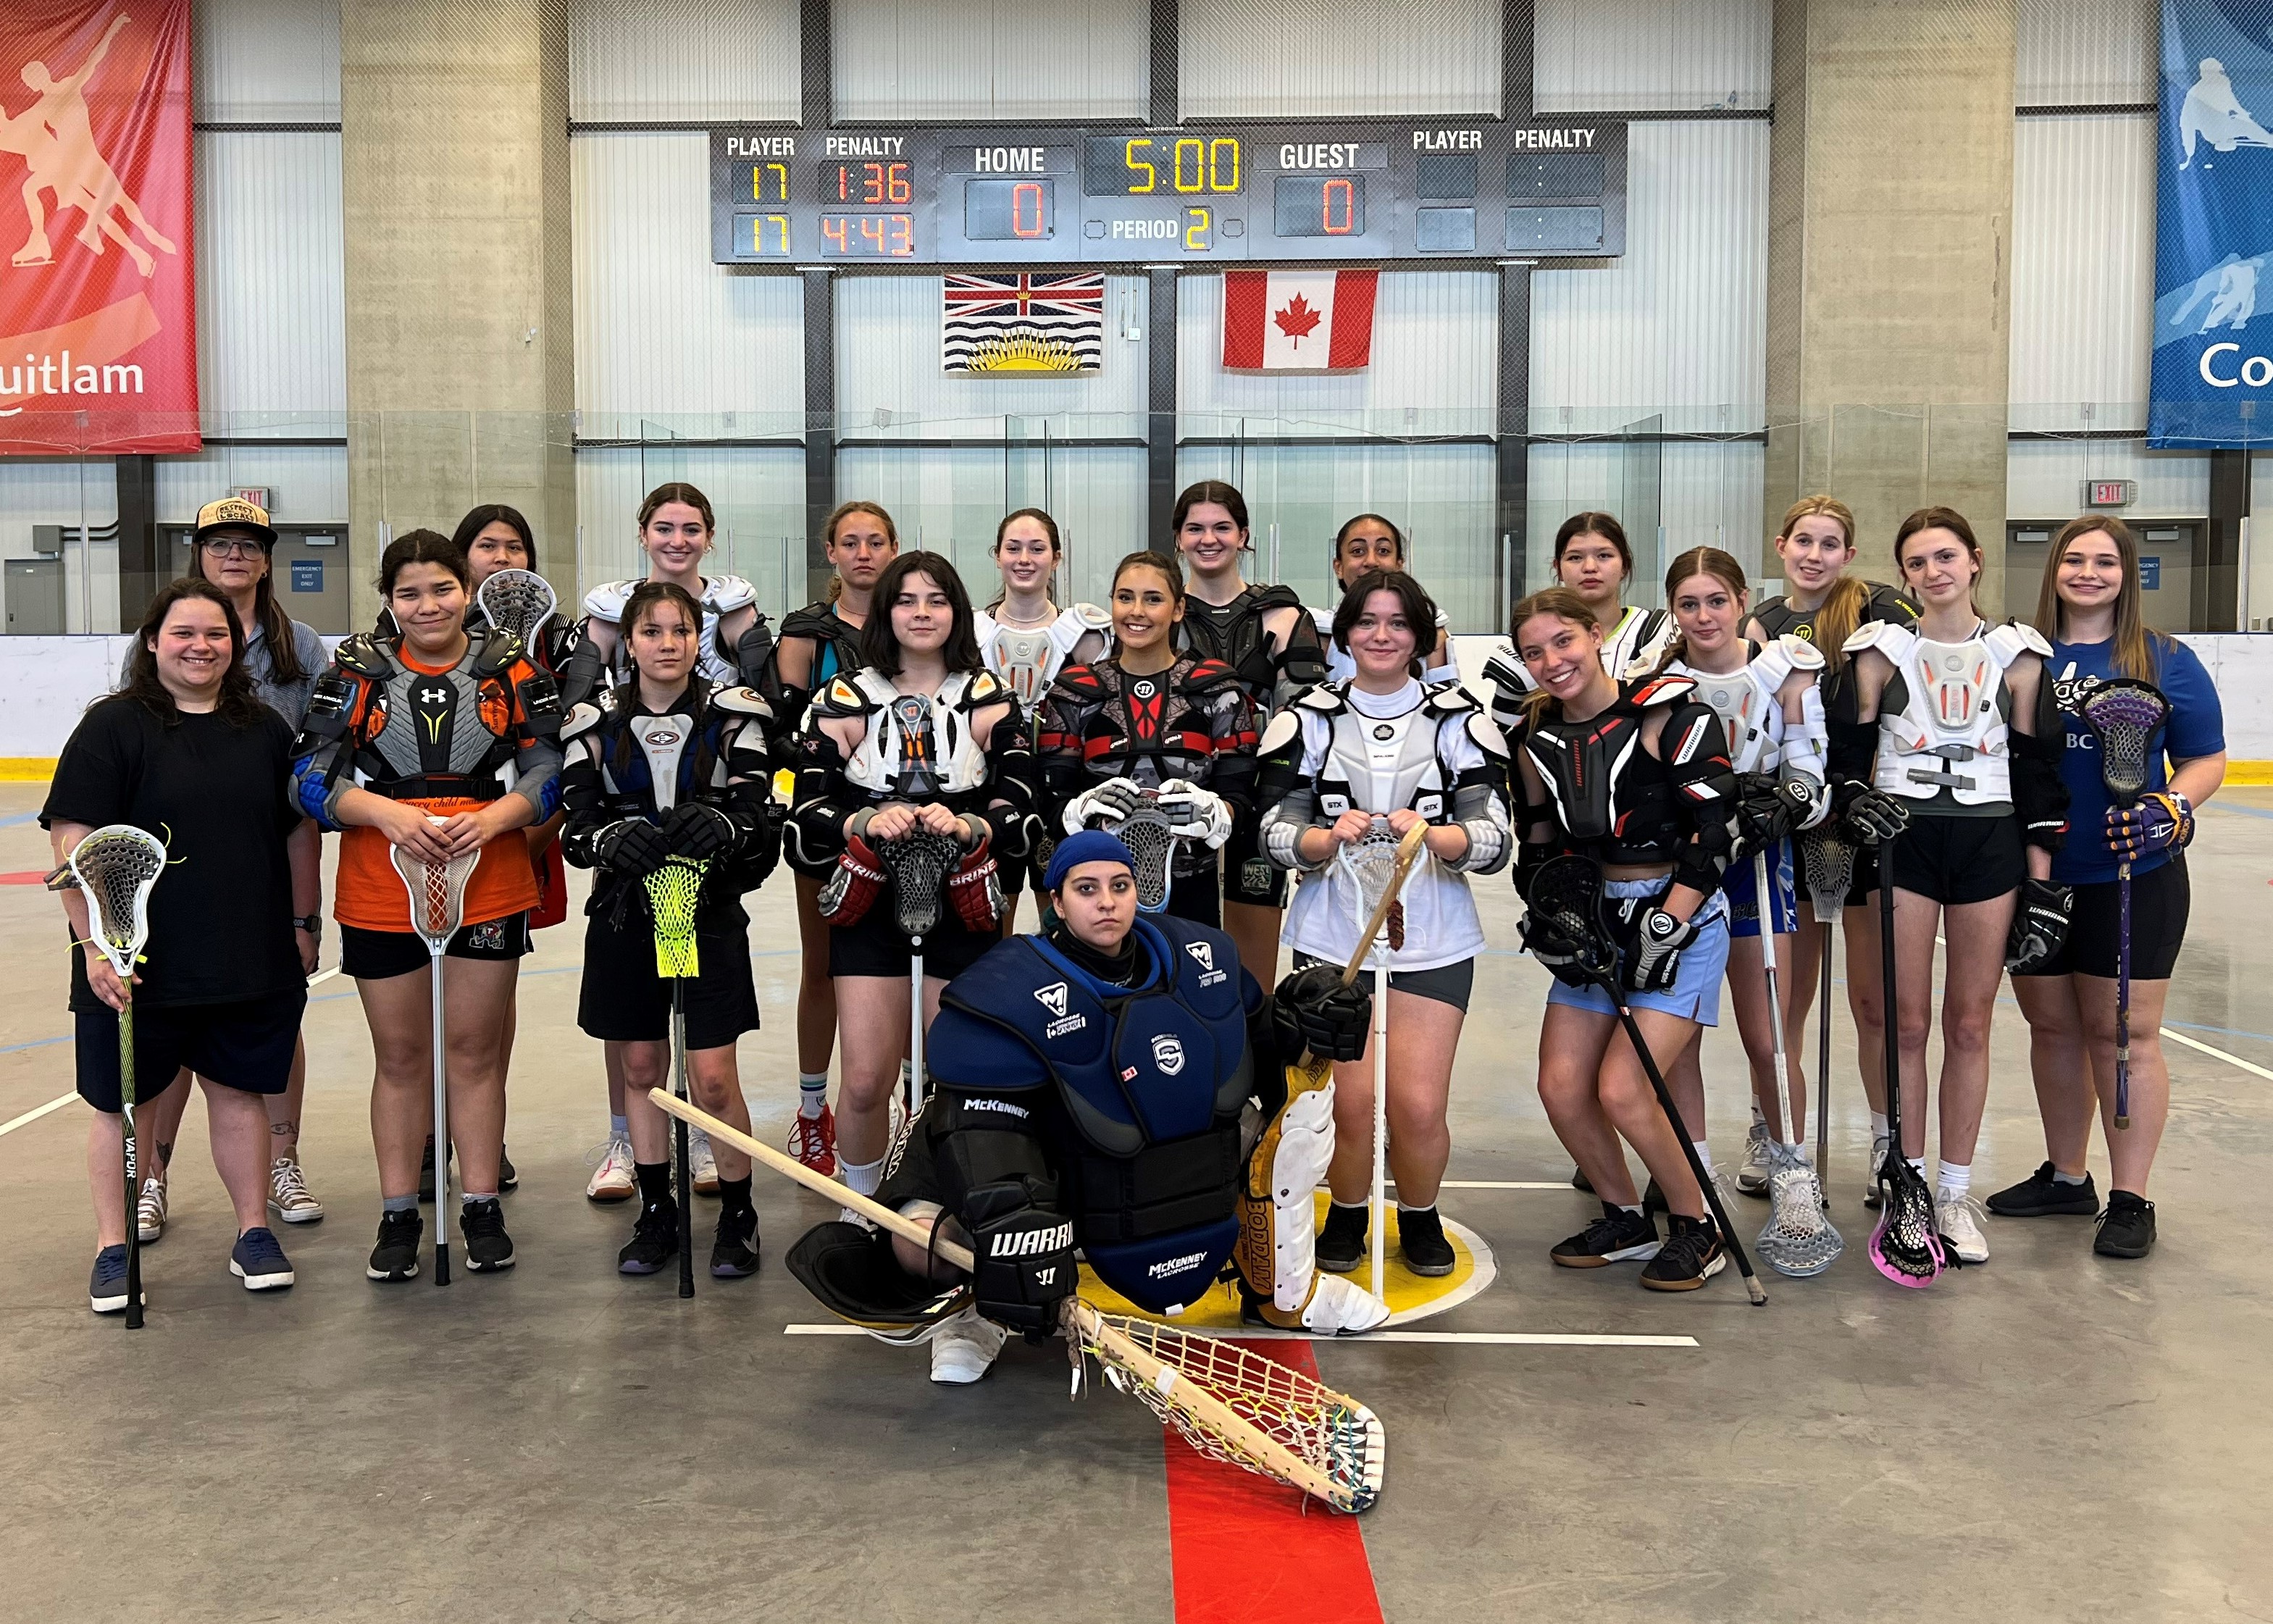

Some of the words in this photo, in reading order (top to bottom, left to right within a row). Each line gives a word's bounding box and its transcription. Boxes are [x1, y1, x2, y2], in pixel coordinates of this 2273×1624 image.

[727, 137, 795, 156] PLAYER
[826, 137, 905, 156] PENALTY
[1412, 130, 1483, 149] PLAYER
[1515, 129, 1596, 148] PENALTY
[974, 147, 1045, 172] HOME
[1125, 138, 1240, 193] 5:00
[1280, 143, 1359, 169] GUEST
[753, 163, 787, 200] 17
[838, 162, 911, 203] 1:36
[1013, 183, 1043, 237] 0
[1323, 178, 1354, 234] 0
[753, 216, 787, 253] 17
[823, 216, 911, 255] 4:43
[1113, 219, 1179, 240] PERIOD
[1186, 209, 1209, 248] 2
[0, 350, 143, 394] uitlam
[2199, 342, 2273, 388] Co
[2097, 484, 2122, 501] EXIT
[219, 504, 254, 515] RESPECT
[219, 513, 254, 522] LOCALS
[2066, 732, 2094, 750] BC
[433, 796, 459, 808] child
[1423, 803, 1439, 813] STX
[842, 857, 889, 883] BRINE
[949, 858, 997, 887] BRINE
[1244, 863, 1271, 876] WEST
[125, 1137, 137, 1179] VAPOR
[1245, 1201, 1272, 1290] BODDAM
[1157, 1261, 1200, 1280] LACROSSE
